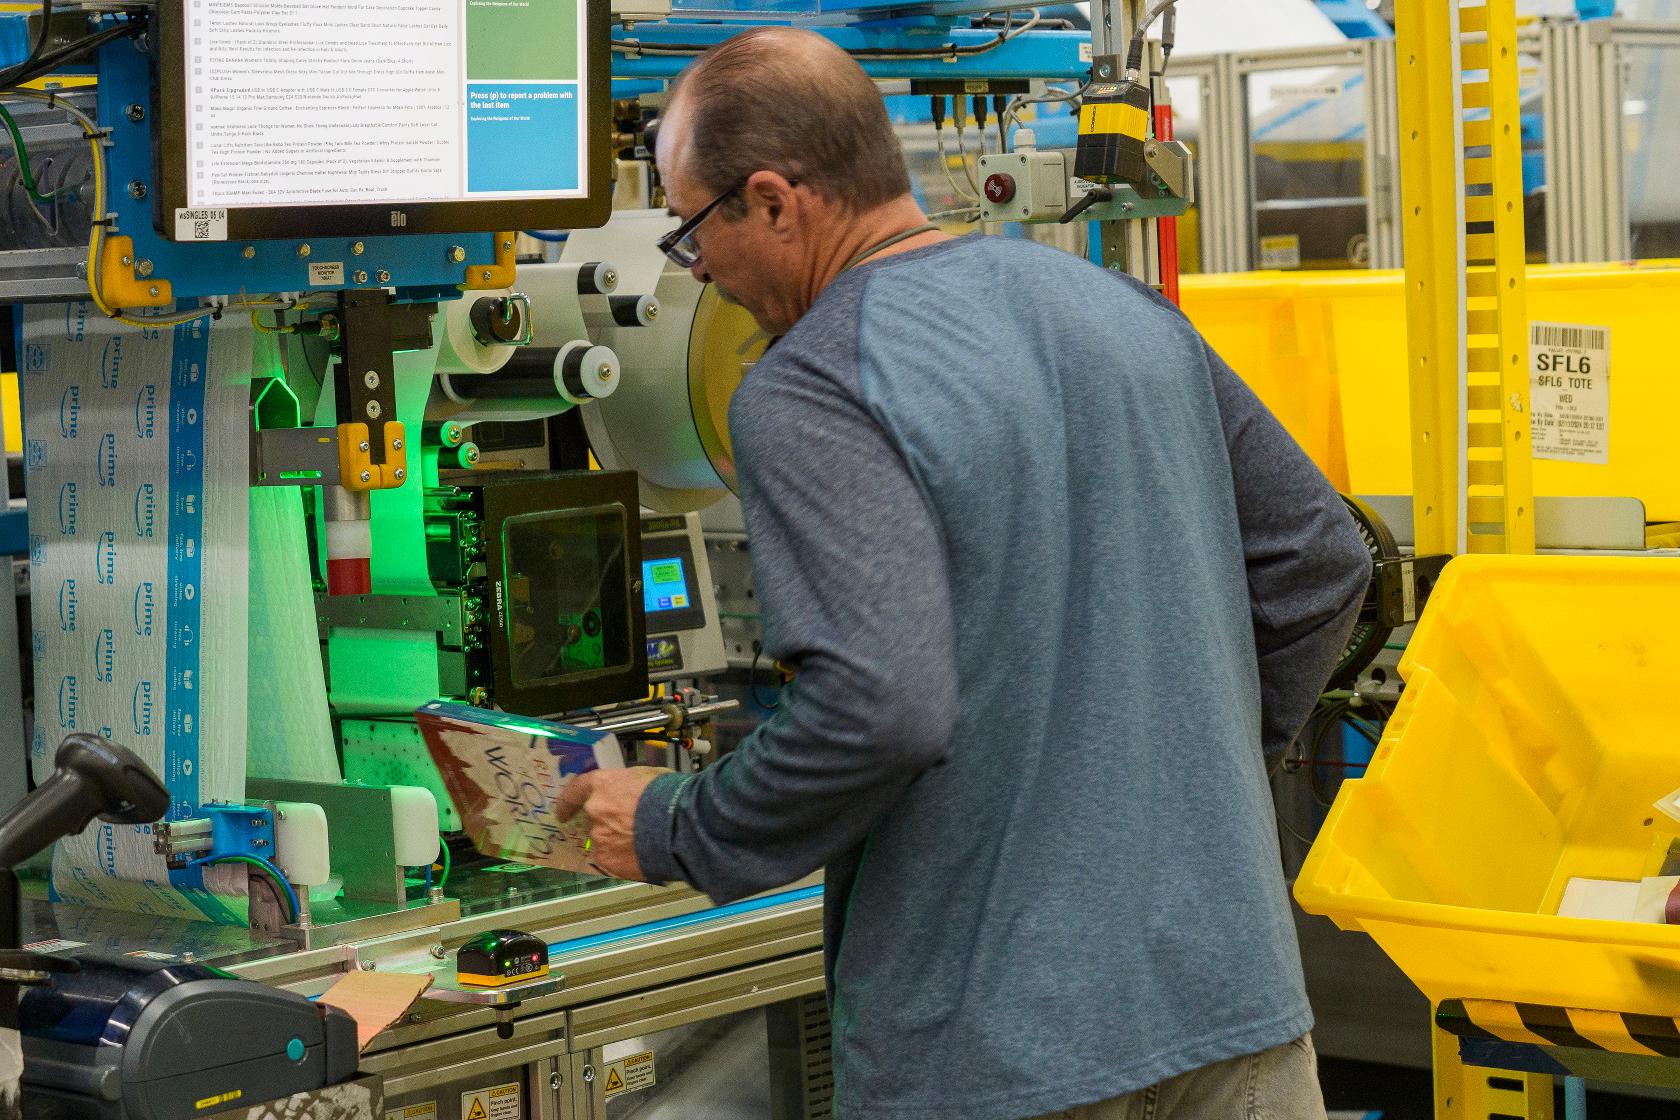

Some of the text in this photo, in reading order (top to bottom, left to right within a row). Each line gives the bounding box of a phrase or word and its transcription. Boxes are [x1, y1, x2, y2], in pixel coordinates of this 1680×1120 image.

[470, 91, 488, 99] Press
[489, 91, 499, 101] (p)
[508, 92, 527, 101] report
[533, 92, 559, 101] problem
[559, 91, 573, 99] with
[470, 101, 510, 109] the last item
[75, 301, 86, 343] rime
[110, 336, 123, 390] prime
[1537, 353, 1591, 374] SFL6
[1538, 375, 1592, 389] SFL6 TOTE
[70, 385, 81, 439] prime
[145, 384, 157, 439] prime
[1559, 394, 1573, 403] WED
[106, 433, 118, 488] prime
[68, 482, 79, 535] prime
[144, 483, 156, 538] prime
[105, 531, 117, 585] prime
[67, 579, 78, 632] prime
[143, 582, 155, 637] prime
[495, 580, 503, 611] ZEBRA
[103, 629, 116, 683] prime
[67, 675, 78, 729] prime
[142, 681, 153, 736] prime
